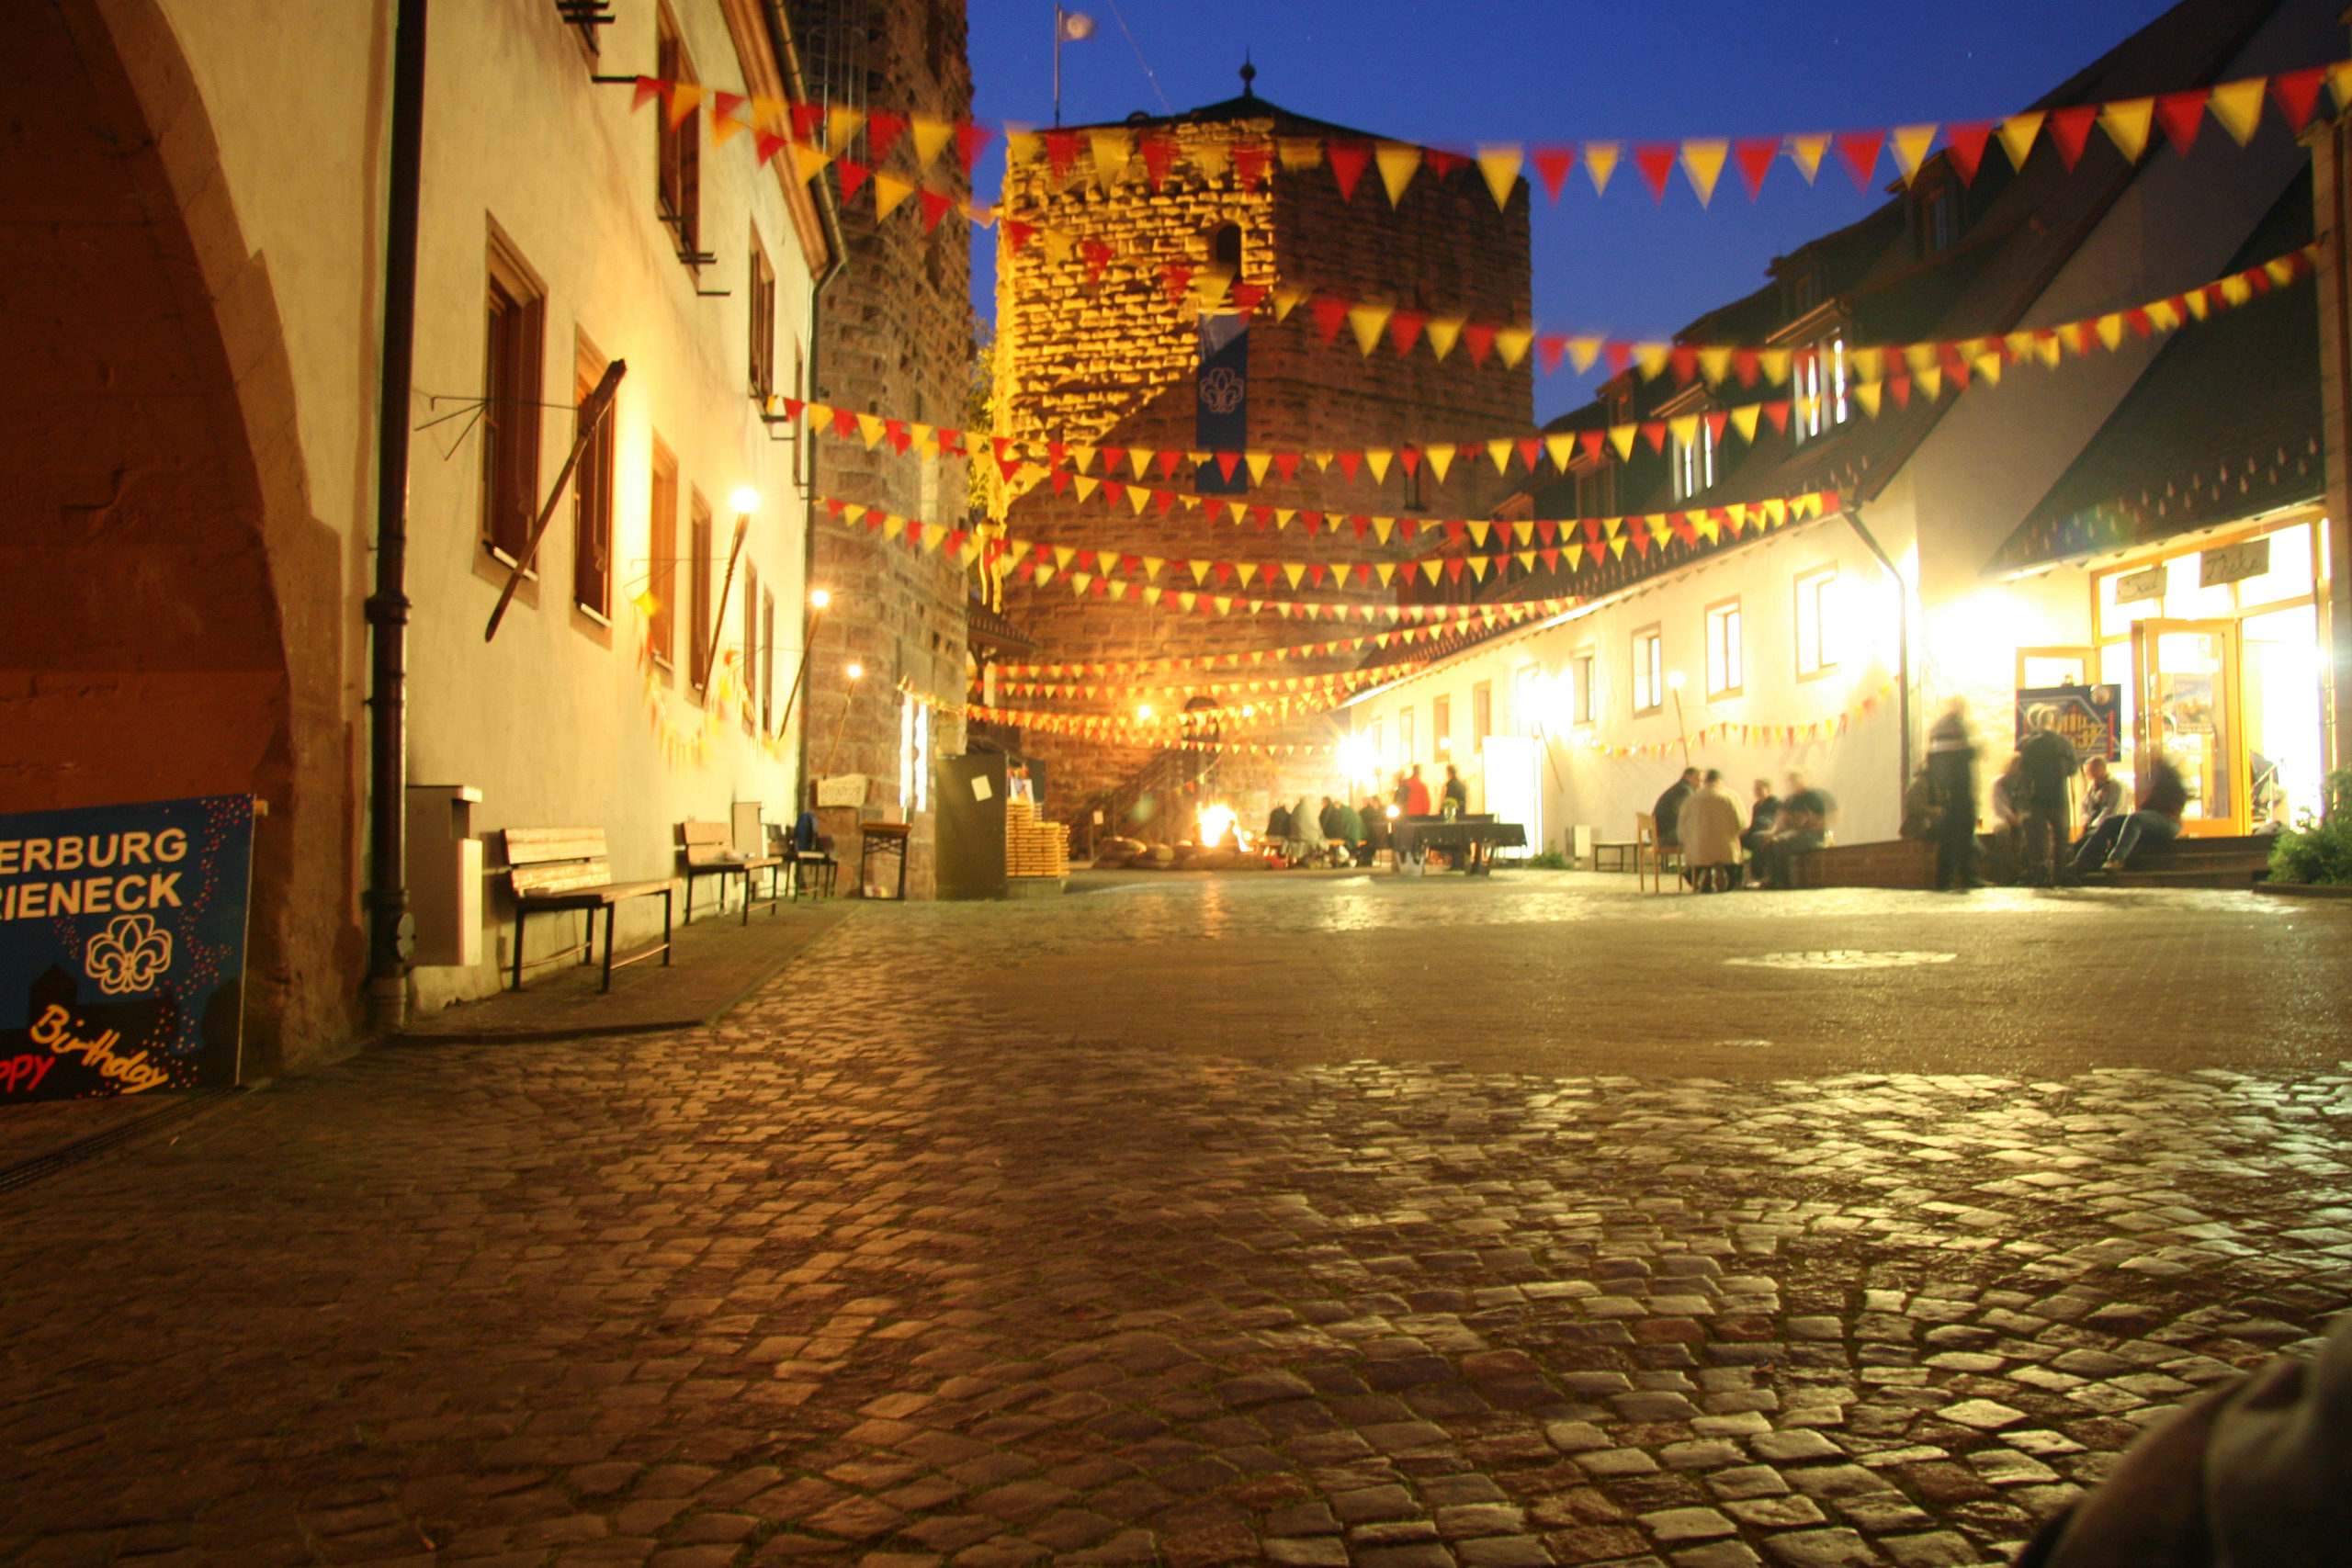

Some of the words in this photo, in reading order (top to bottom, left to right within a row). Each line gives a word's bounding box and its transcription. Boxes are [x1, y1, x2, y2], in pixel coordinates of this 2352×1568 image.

[0, 828, 187, 874] ERBURG
[0, 872, 182, 920] IENECK
[30, 1004, 169, 1094] Birthday
